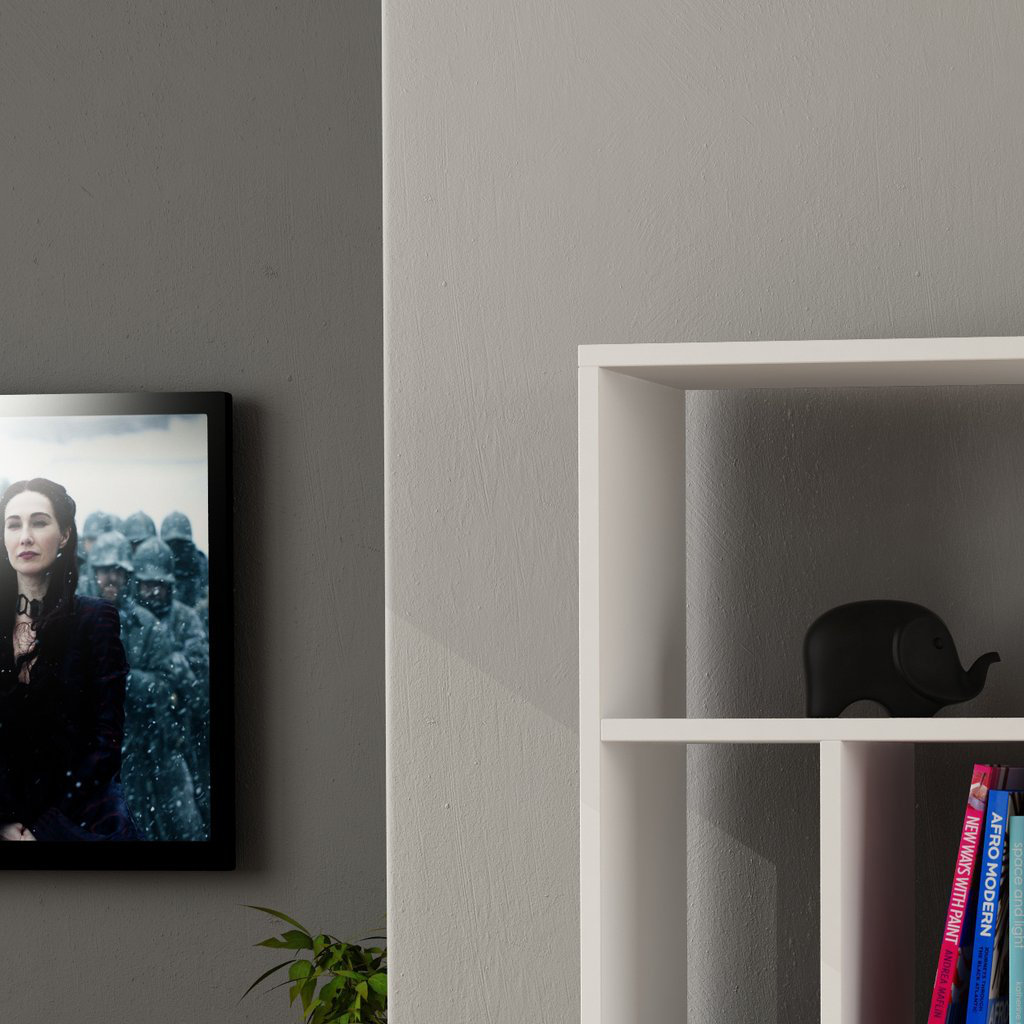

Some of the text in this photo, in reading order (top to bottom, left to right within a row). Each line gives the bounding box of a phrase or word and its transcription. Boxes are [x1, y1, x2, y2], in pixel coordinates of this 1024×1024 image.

[945, 816, 980, 945] NEW WAYS WITH PAINT
[980, 812, 1003, 937] AFRO MODERN
[1012, 842, 1024, 948] space and light
[934, 950, 953, 1018] ANDREA MAFLIN
